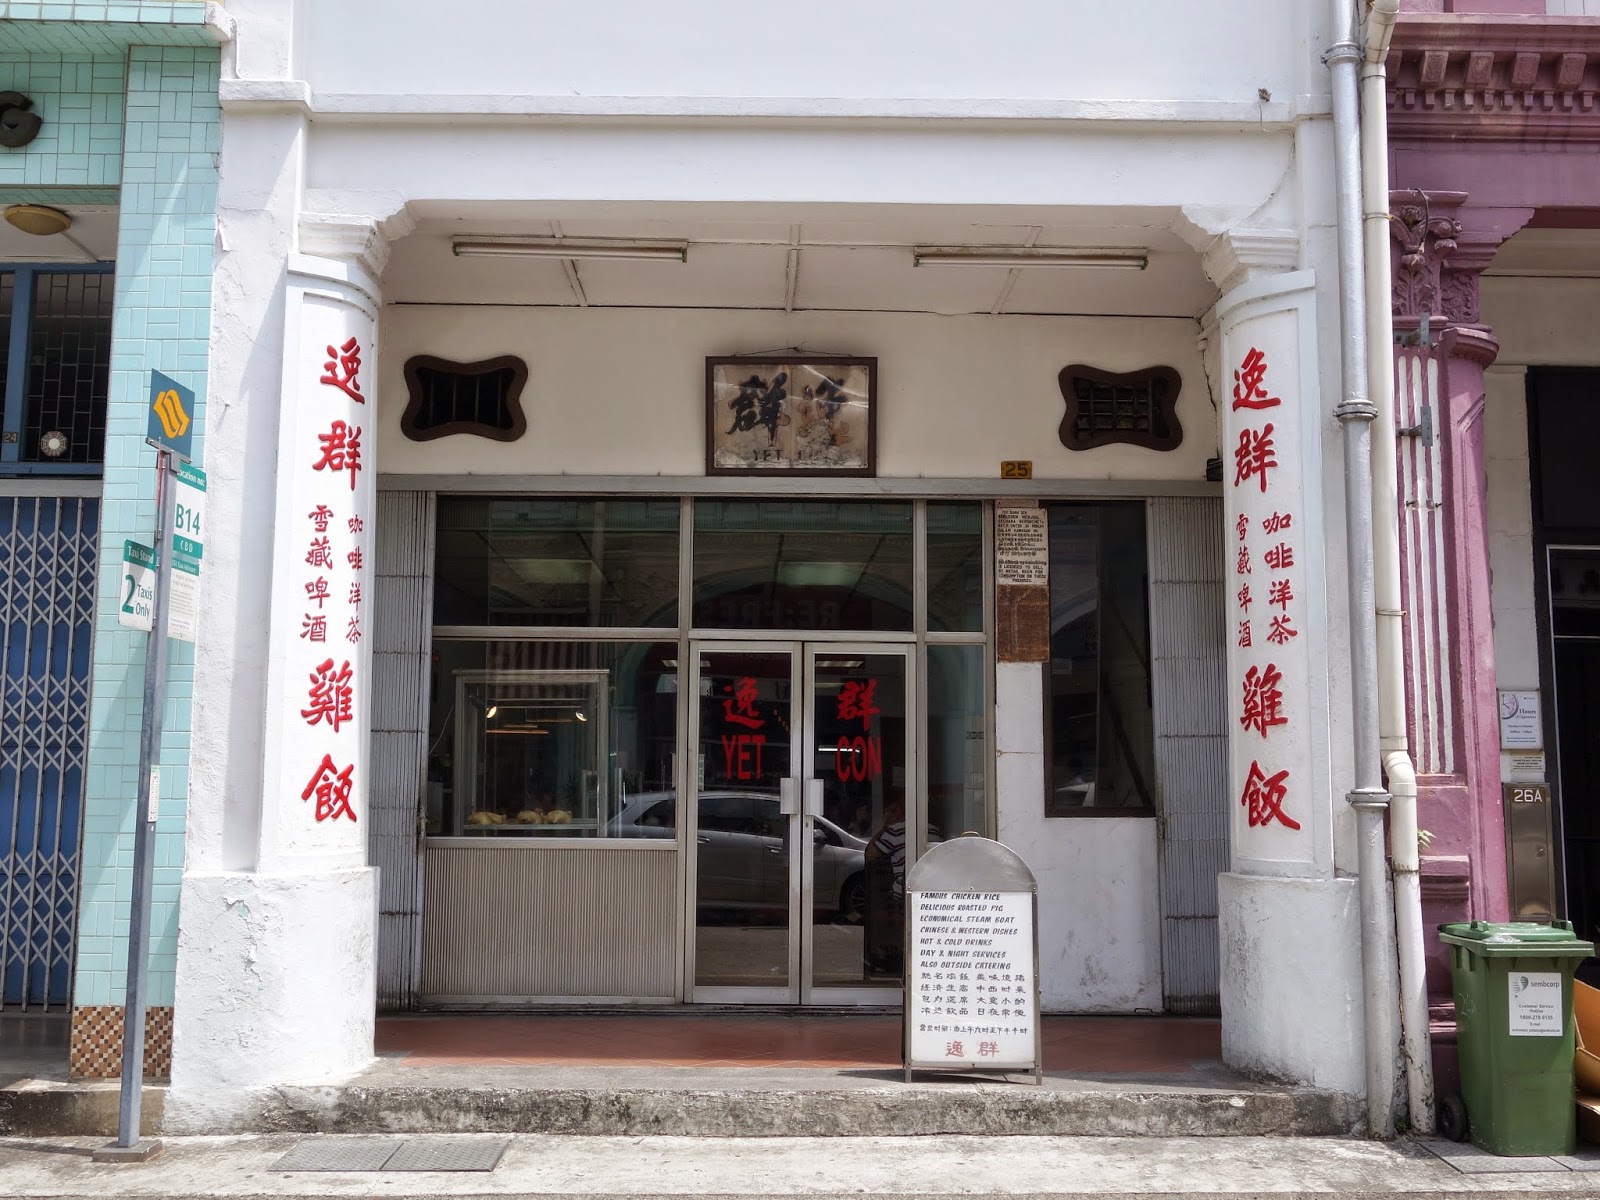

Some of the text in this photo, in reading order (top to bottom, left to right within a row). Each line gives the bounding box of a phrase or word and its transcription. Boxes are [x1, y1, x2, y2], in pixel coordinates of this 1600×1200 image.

[312, 336, 365, 491] 逸群
[1232, 347, 1282, 493] 逸群
[4, 432, 17, 443] 24
[177, 469, 196, 483] ocation
[1005, 462, 1028, 477] 25
[176, 503, 200, 536] B14
[128, 545, 154, 564] Taxi Stand
[180, 540, 193, 553] CBD
[300, 504, 334, 645] 雪藏啤酒
[347, 514, 364, 645] 咖啡洋茶
[1236, 514, 1252, 648] 雪藏啤酒
[1263, 512, 1298, 645] 咖啡洋茶
[122, 574, 136, 614] 2
[137, 584, 153, 601] Taxis
[135, 602, 151, 621] Only
[722, 676, 881, 733] 逸 群
[300, 656, 359, 824] 雞飯
[1240, 663, 1301, 831] 雞飯
[722, 735, 882, 783] YET CON
[1514, 789, 1543, 803] 26A
[920, 892, 1001, 901] FAMOUS CHICKEN RICE
[920, 903, 955, 911] DELICIOUS
[995, 916, 1015, 924] BOAT
[920, 926, 949, 934] CHINESE
[958, 927, 990, 935] WESTERN
[945, 938, 963, 946] COLD
[920, 949, 936, 957] DAY
[972, 950, 1007, 958] SERVICES
[940, 961, 972, 969] OUTSIDE
[975, 962, 1011, 970] CATERING
[1530, 980, 1560, 989] sembcorp
[944, 1040, 1000, 1058] 逸群
